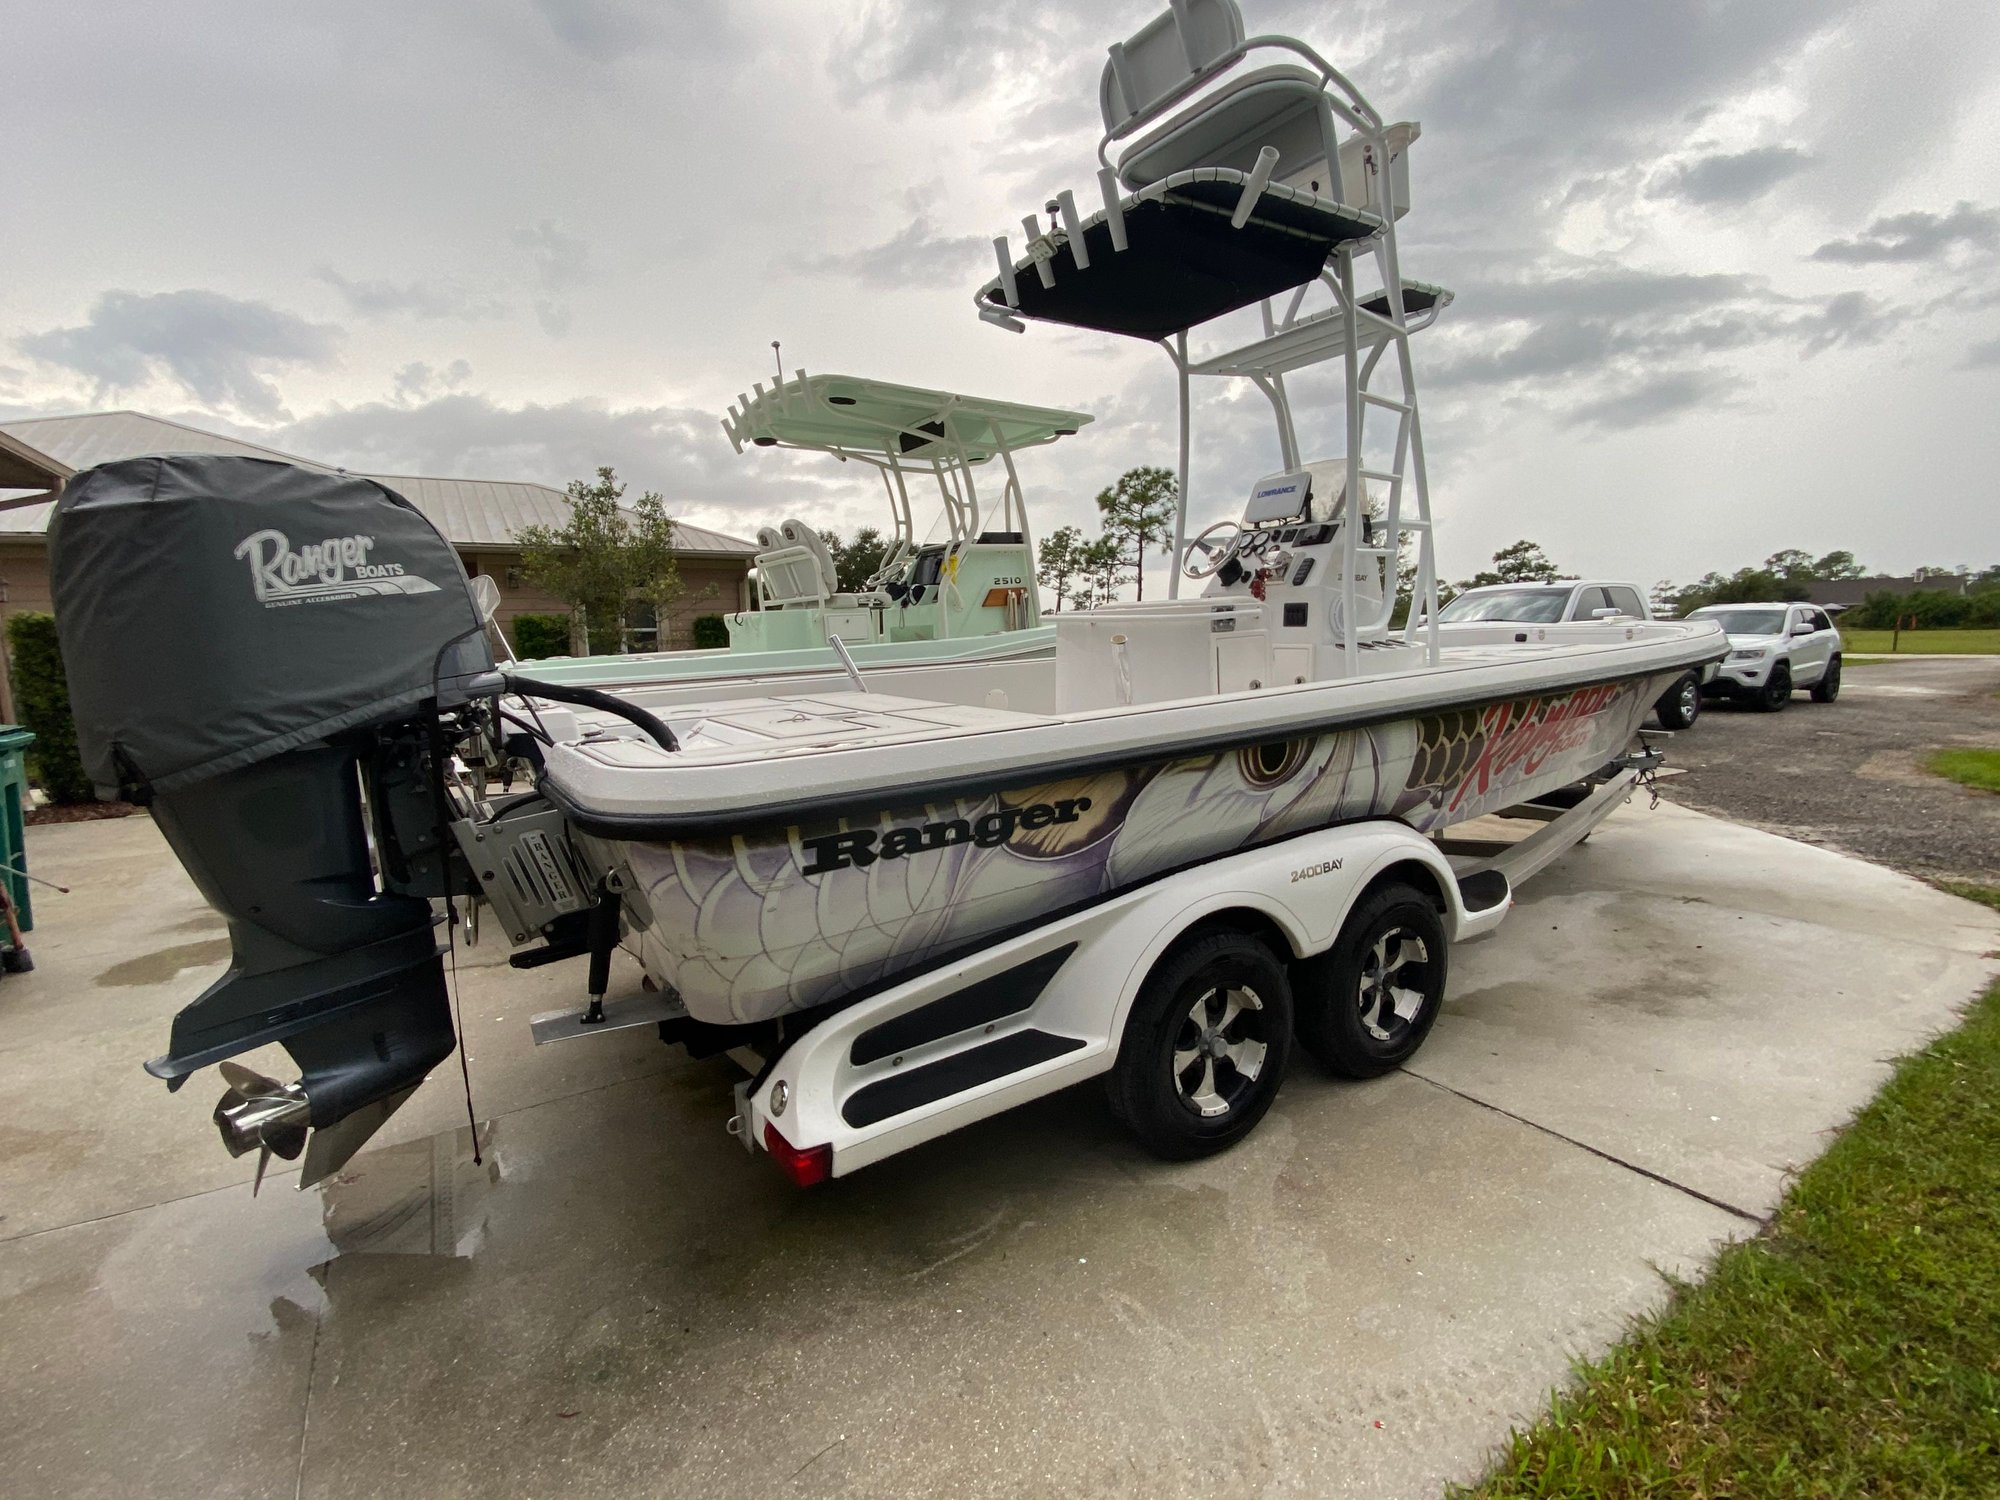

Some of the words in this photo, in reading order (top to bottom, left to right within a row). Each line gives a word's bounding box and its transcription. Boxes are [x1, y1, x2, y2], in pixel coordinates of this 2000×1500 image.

[1257, 485, 1297, 499] LOWRANCE
[234, 528, 374, 602] Ranger
[355, 563, 404, 579] BOATS
[993, 576, 1022, 585] 2510
[264, 599, 303, 609] GENUINE
[304, 593, 358, 604] ACCESSORIES
[801, 796, 1092, 877] Ranger
[533, 842, 568, 901] RANGER
